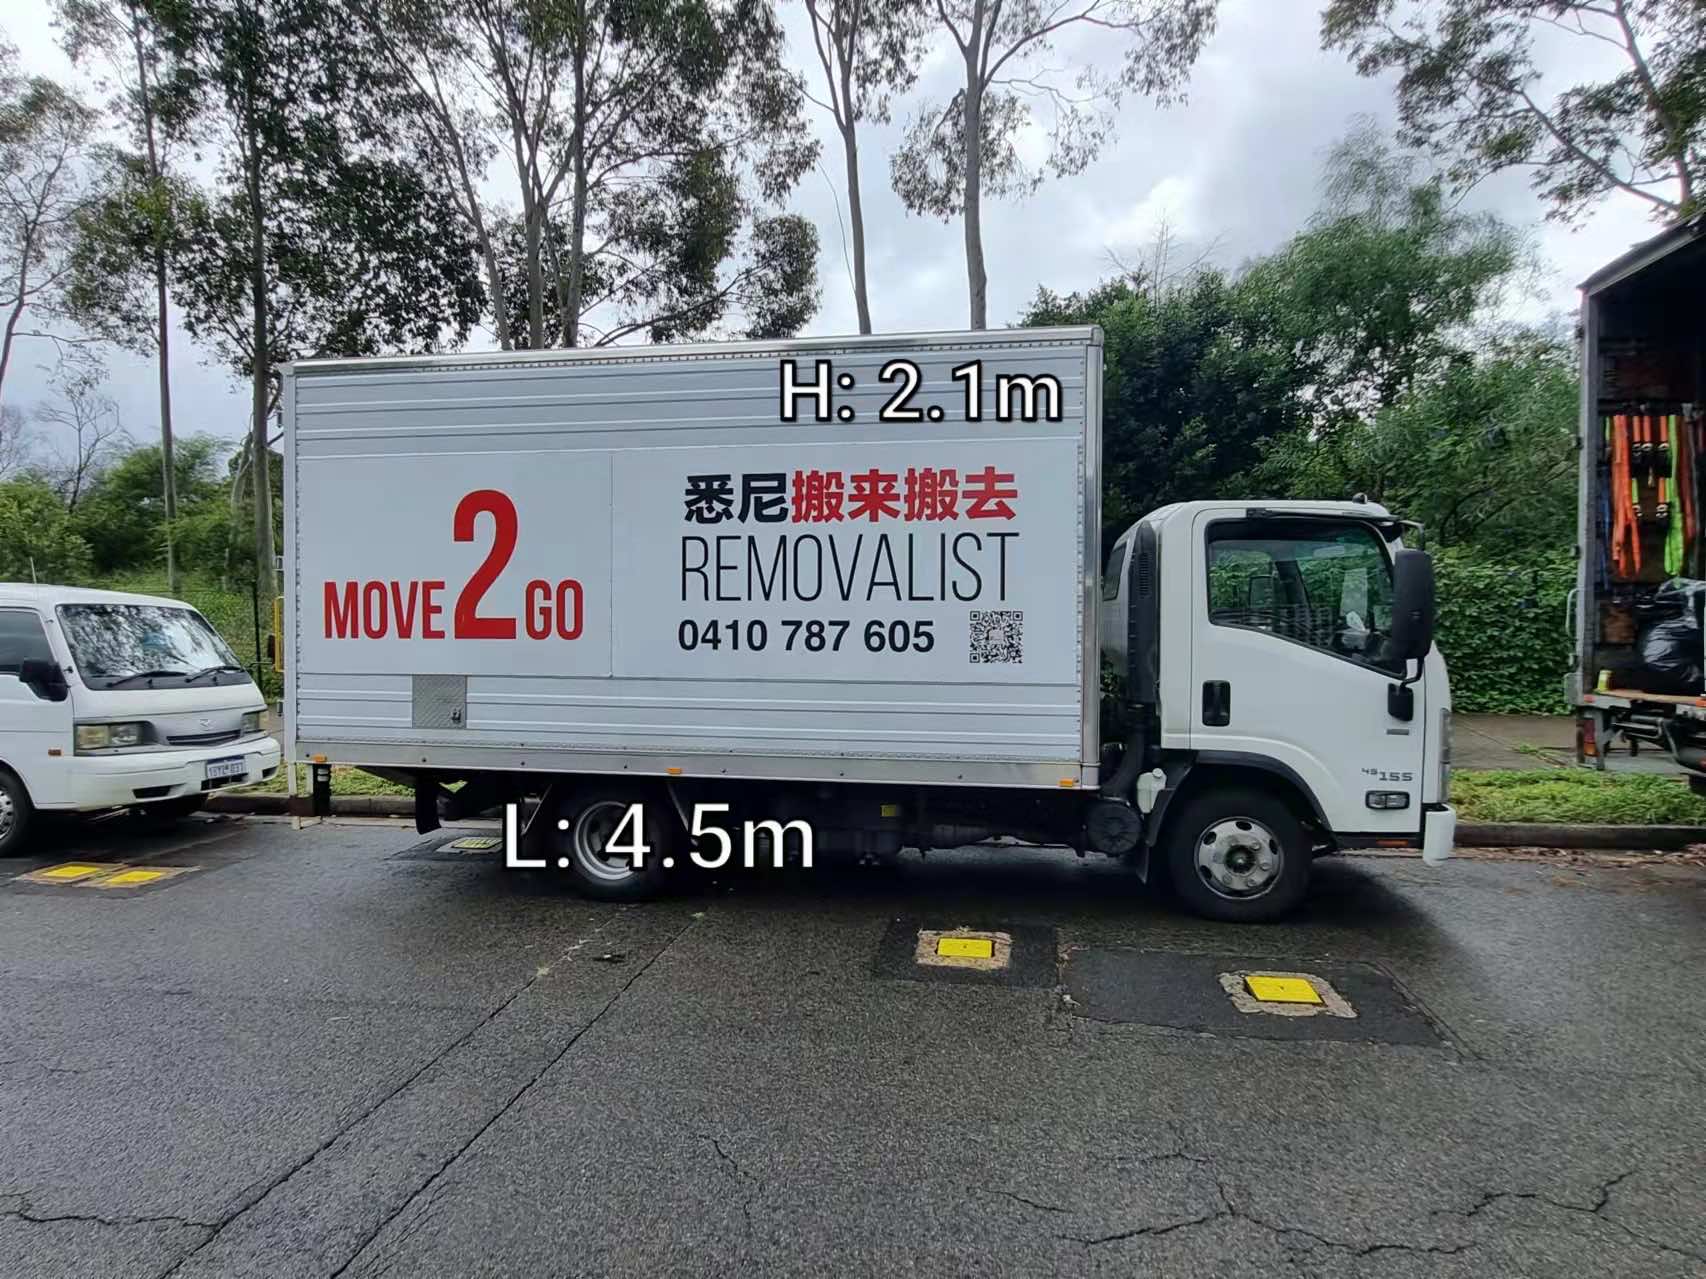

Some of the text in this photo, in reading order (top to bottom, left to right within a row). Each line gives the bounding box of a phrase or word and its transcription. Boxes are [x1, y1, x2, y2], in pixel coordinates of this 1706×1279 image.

[684, 466, 1018, 524] 悉尼搬来搬去
[324, 489, 584, 641] MOVE 2 GO
[681, 532, 1020, 602] REMOVALIST
[678, 619, 935, 653] 0410 787 605
[1378, 771, 1414, 782] 155
